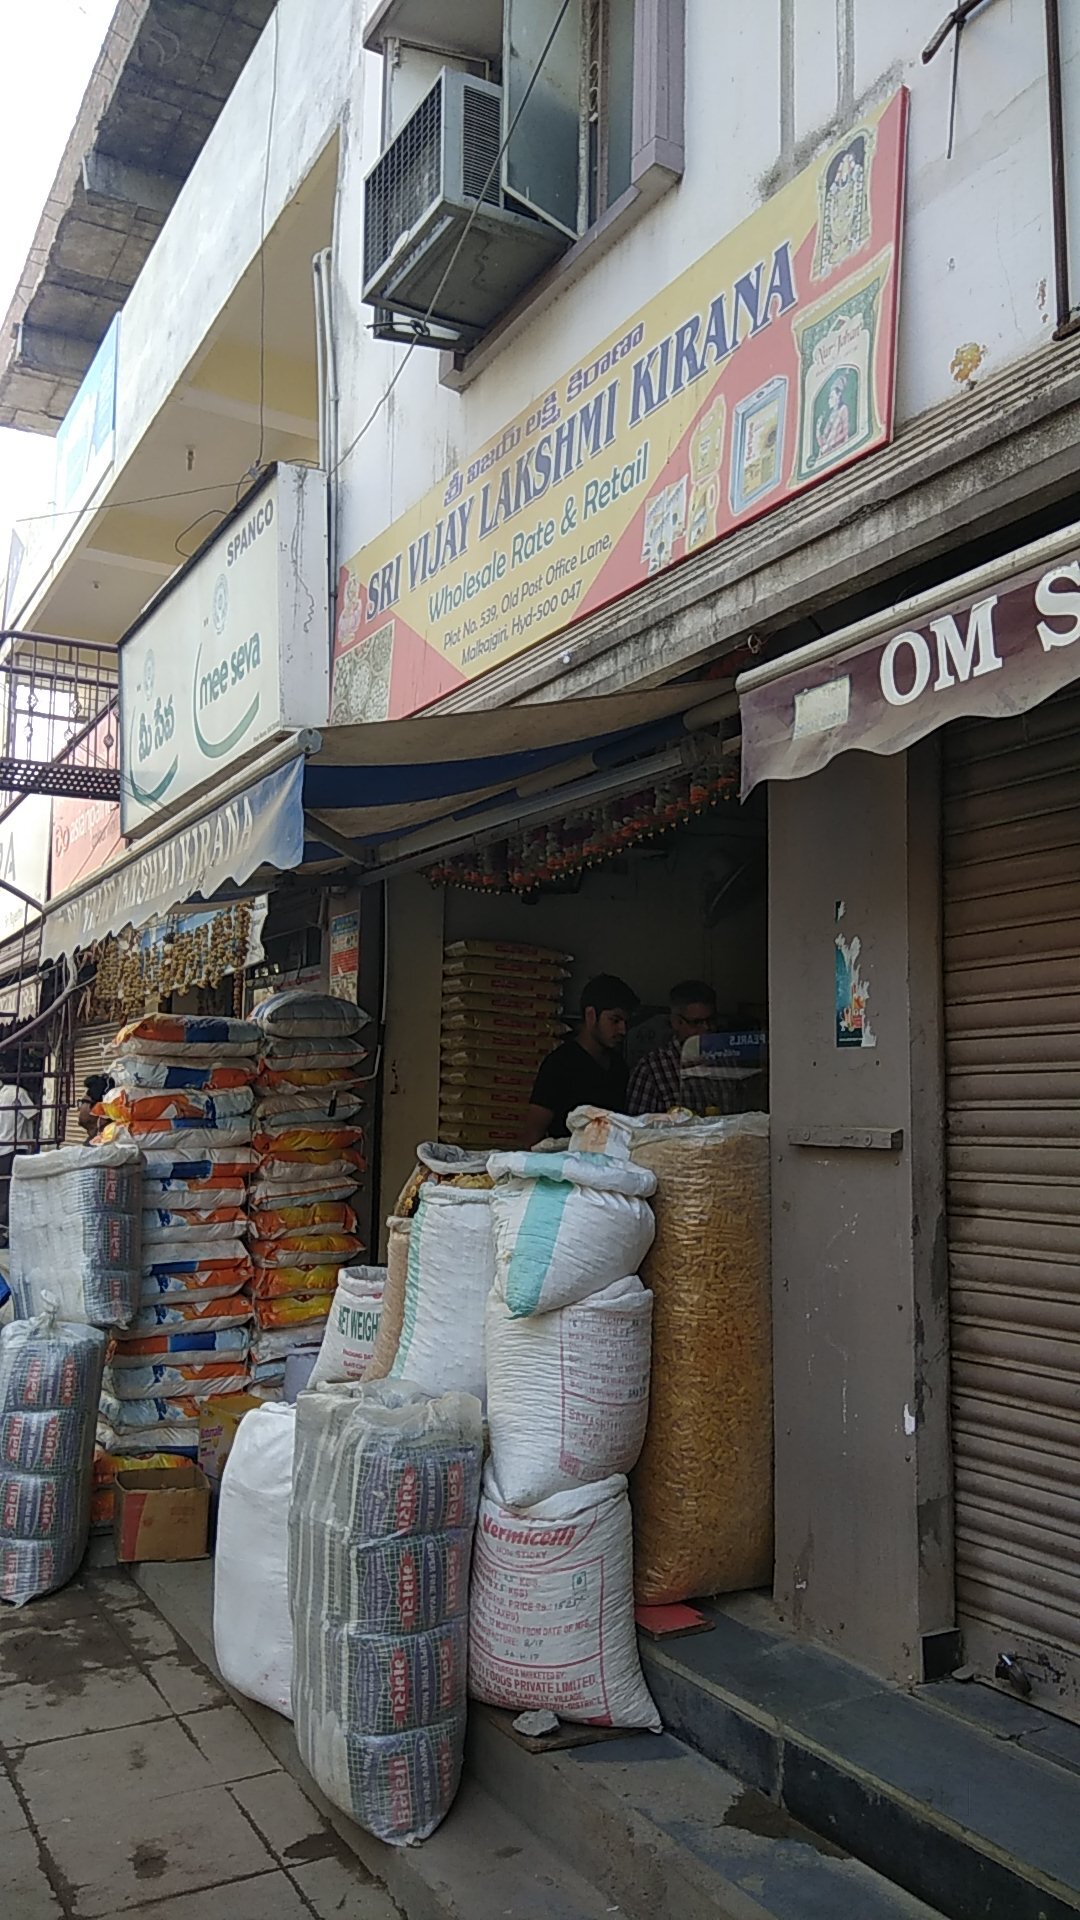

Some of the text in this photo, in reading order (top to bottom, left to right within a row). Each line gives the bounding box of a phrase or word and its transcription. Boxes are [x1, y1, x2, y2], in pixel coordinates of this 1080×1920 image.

[366, 240, 798, 623] SRI VIJAY LAKSHMI KIRANA
[444, 470, 464, 507] శ్రీ
[566, 322, 644, 403] కిరాణా
[226, 498, 274, 567] SPANCO
[428, 442, 650, 623] Wholesale Rate & Retail
[443, 533, 613, 651] Plot No. 539, Old Post Office Lane,
[511, 594, 559, 637] Hyd-500
[560, 579, 583, 607] 047
[199, 632, 262, 711] mee seva
[880, 594, 1003, 706] OM
[178, 796, 253, 886] KIRANA
[482, 1513, 577, 1546] Vermicelli
[522, 1626, 541, 1636] FROM
[543, 1625, 562, 1636] DATE
[564, 1624, 574, 1634] OF
[486, 1668, 512, 1688] FOODS
[514, 1679, 554, 1694] PRIVATE
